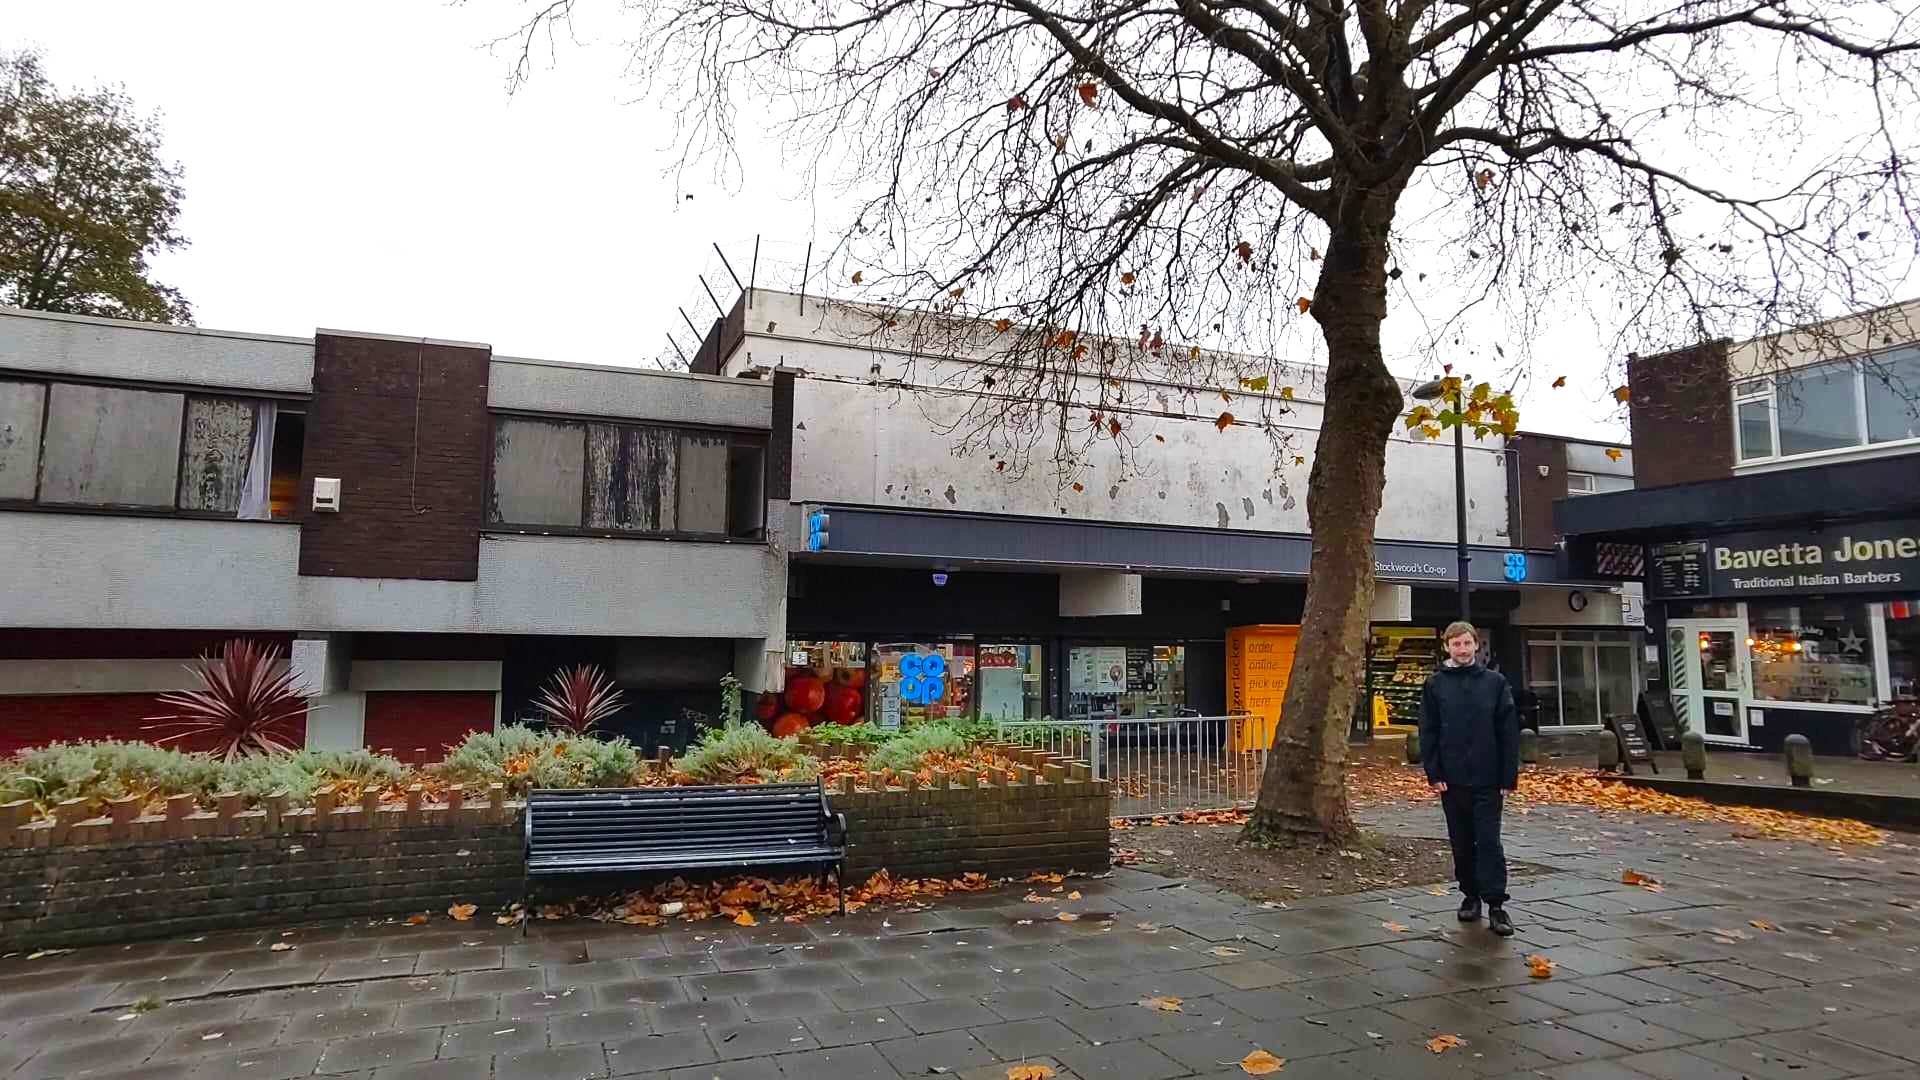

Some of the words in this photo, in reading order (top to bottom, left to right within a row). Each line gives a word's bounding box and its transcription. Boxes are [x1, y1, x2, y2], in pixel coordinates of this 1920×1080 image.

[1714, 543, 1823, 570] Bavetta
[1374, 560, 1423, 573] Stockwood's
[1423, 563, 1447, 577] Co-op
[1732, 576, 1795, 589] Traditional
[1799, 573, 1840, 586] Italian
[1844, 570, 1902, 585] Barbers
[1248, 642, 1273, 654] order
[1249, 679, 1269, 691] pick
[1271, 679, 1284, 691] up
